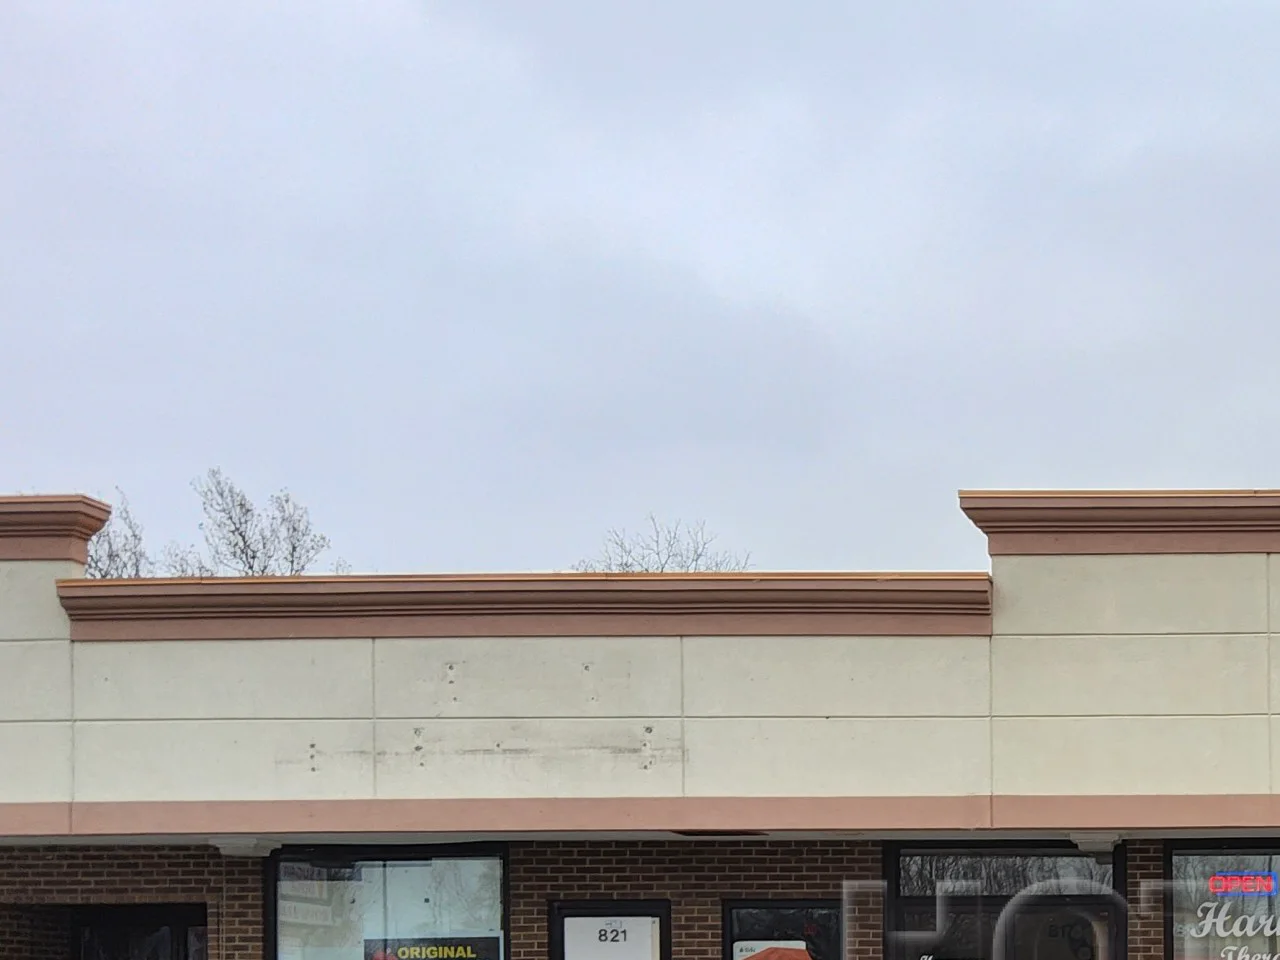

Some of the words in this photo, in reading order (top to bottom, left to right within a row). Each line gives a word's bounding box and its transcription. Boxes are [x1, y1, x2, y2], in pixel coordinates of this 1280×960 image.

[1209, 875, 1273, 893] OPEN
[598, 929, 627, 942] 821
[397, 946, 476, 959] ORIGINAL
